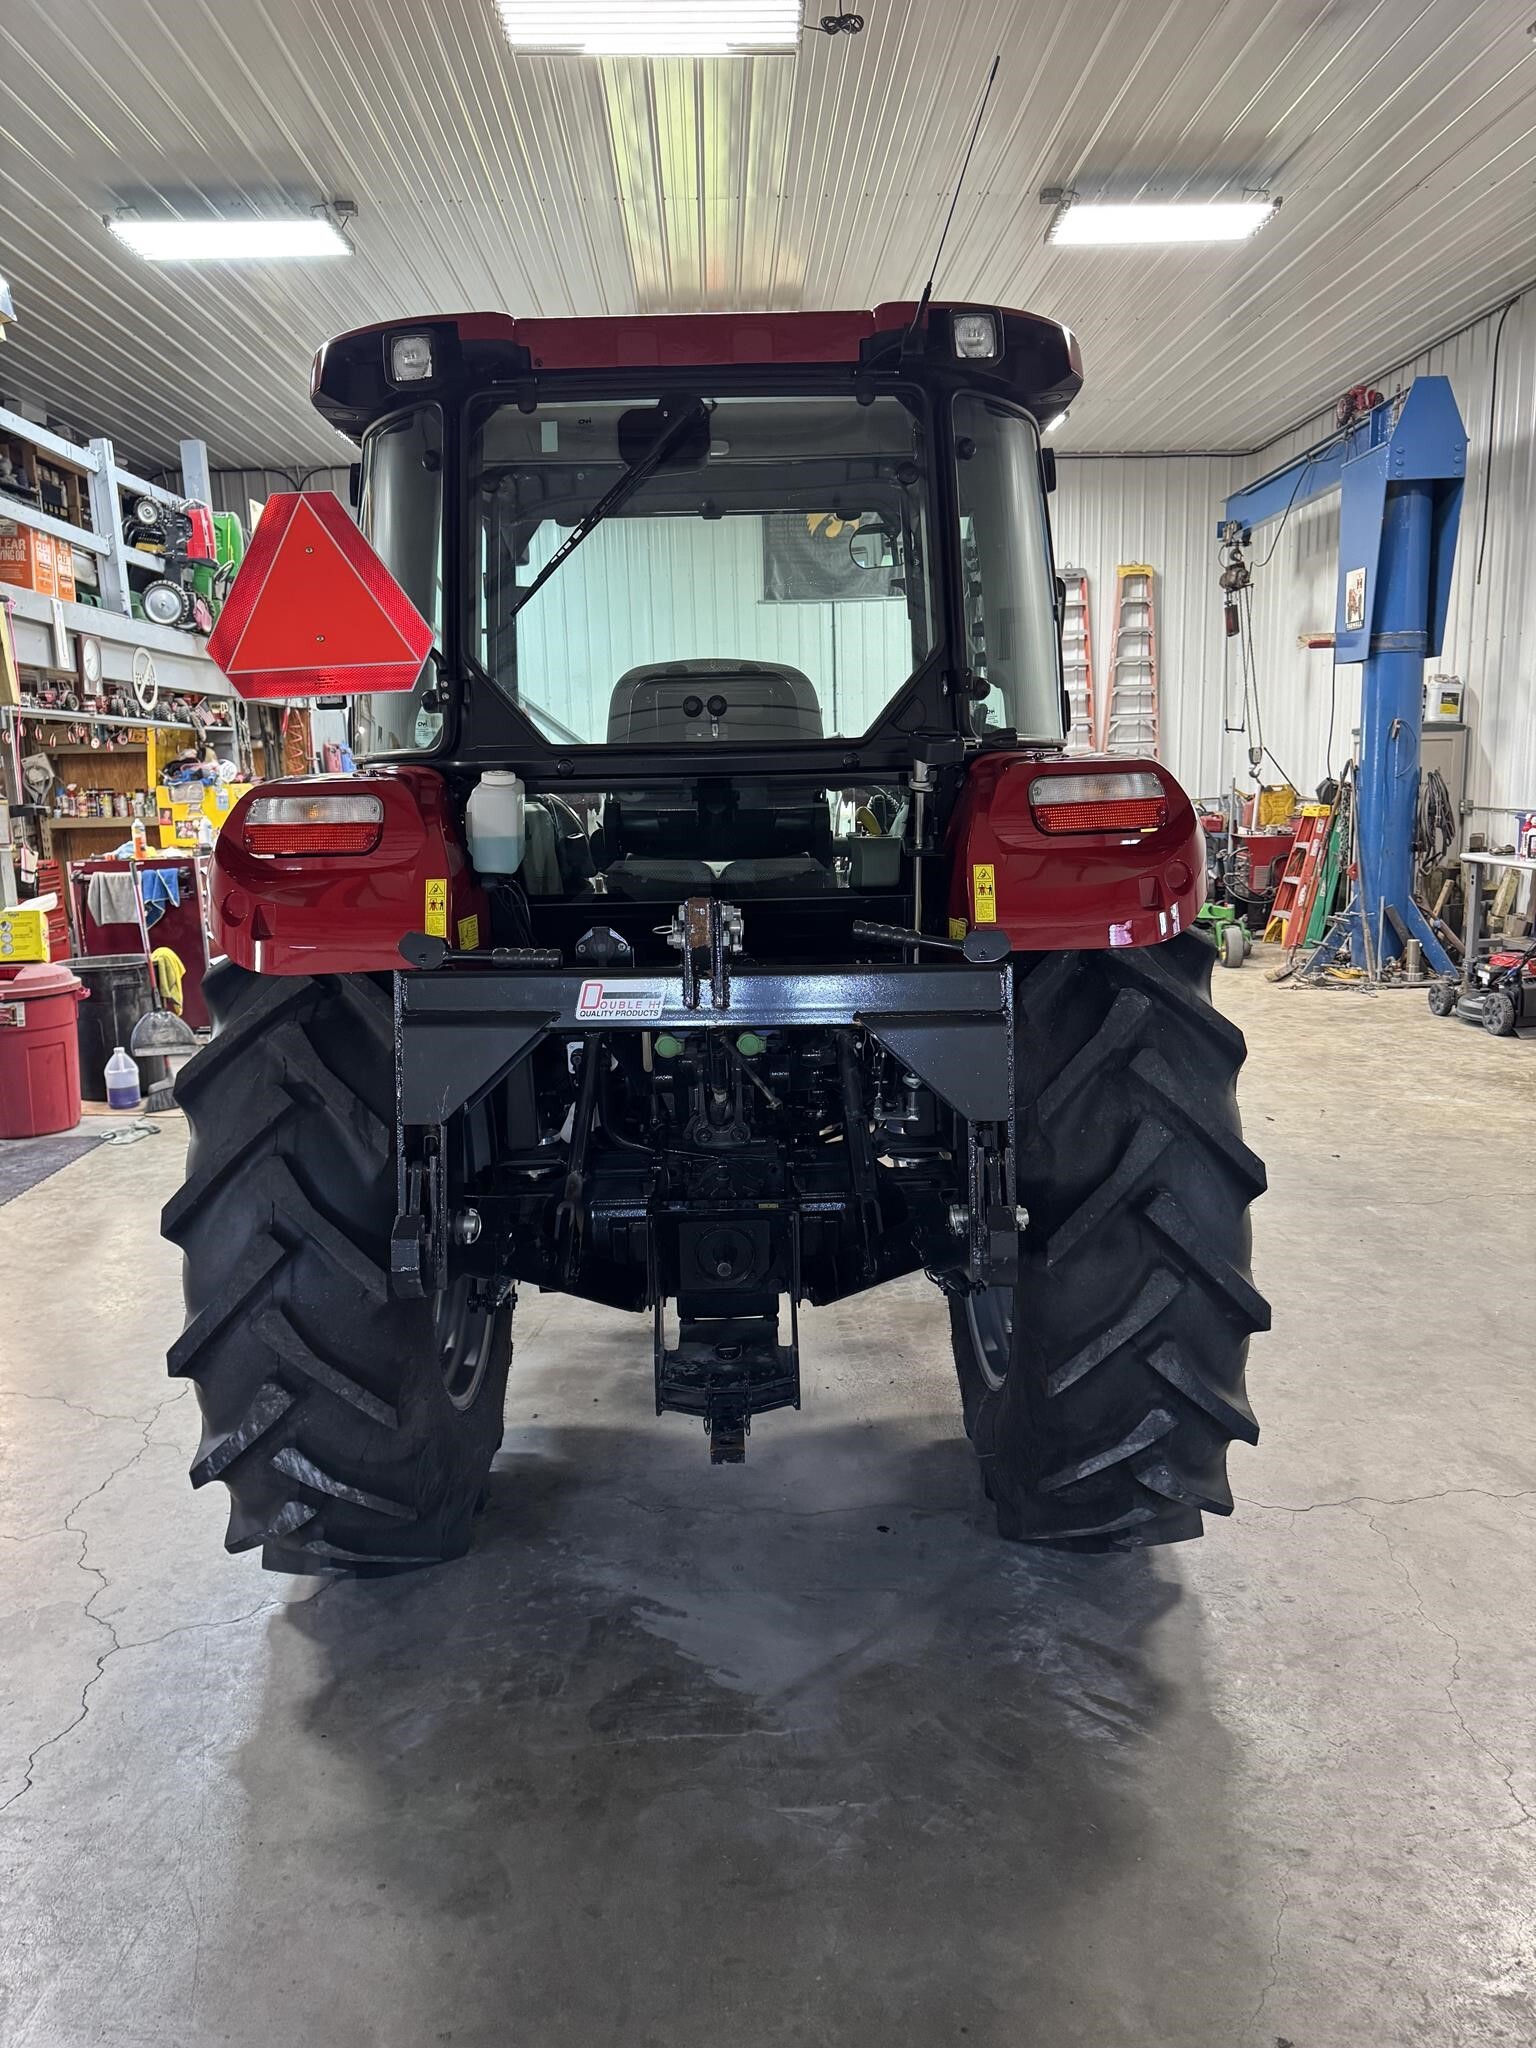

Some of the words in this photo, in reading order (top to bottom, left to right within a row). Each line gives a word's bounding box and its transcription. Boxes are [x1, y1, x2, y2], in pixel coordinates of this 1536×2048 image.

[0, 538, 26, 550] LEAR
[580, 983, 643, 1009] DOUBLE
[615, 1009, 659, 1017] PRODUCTS
